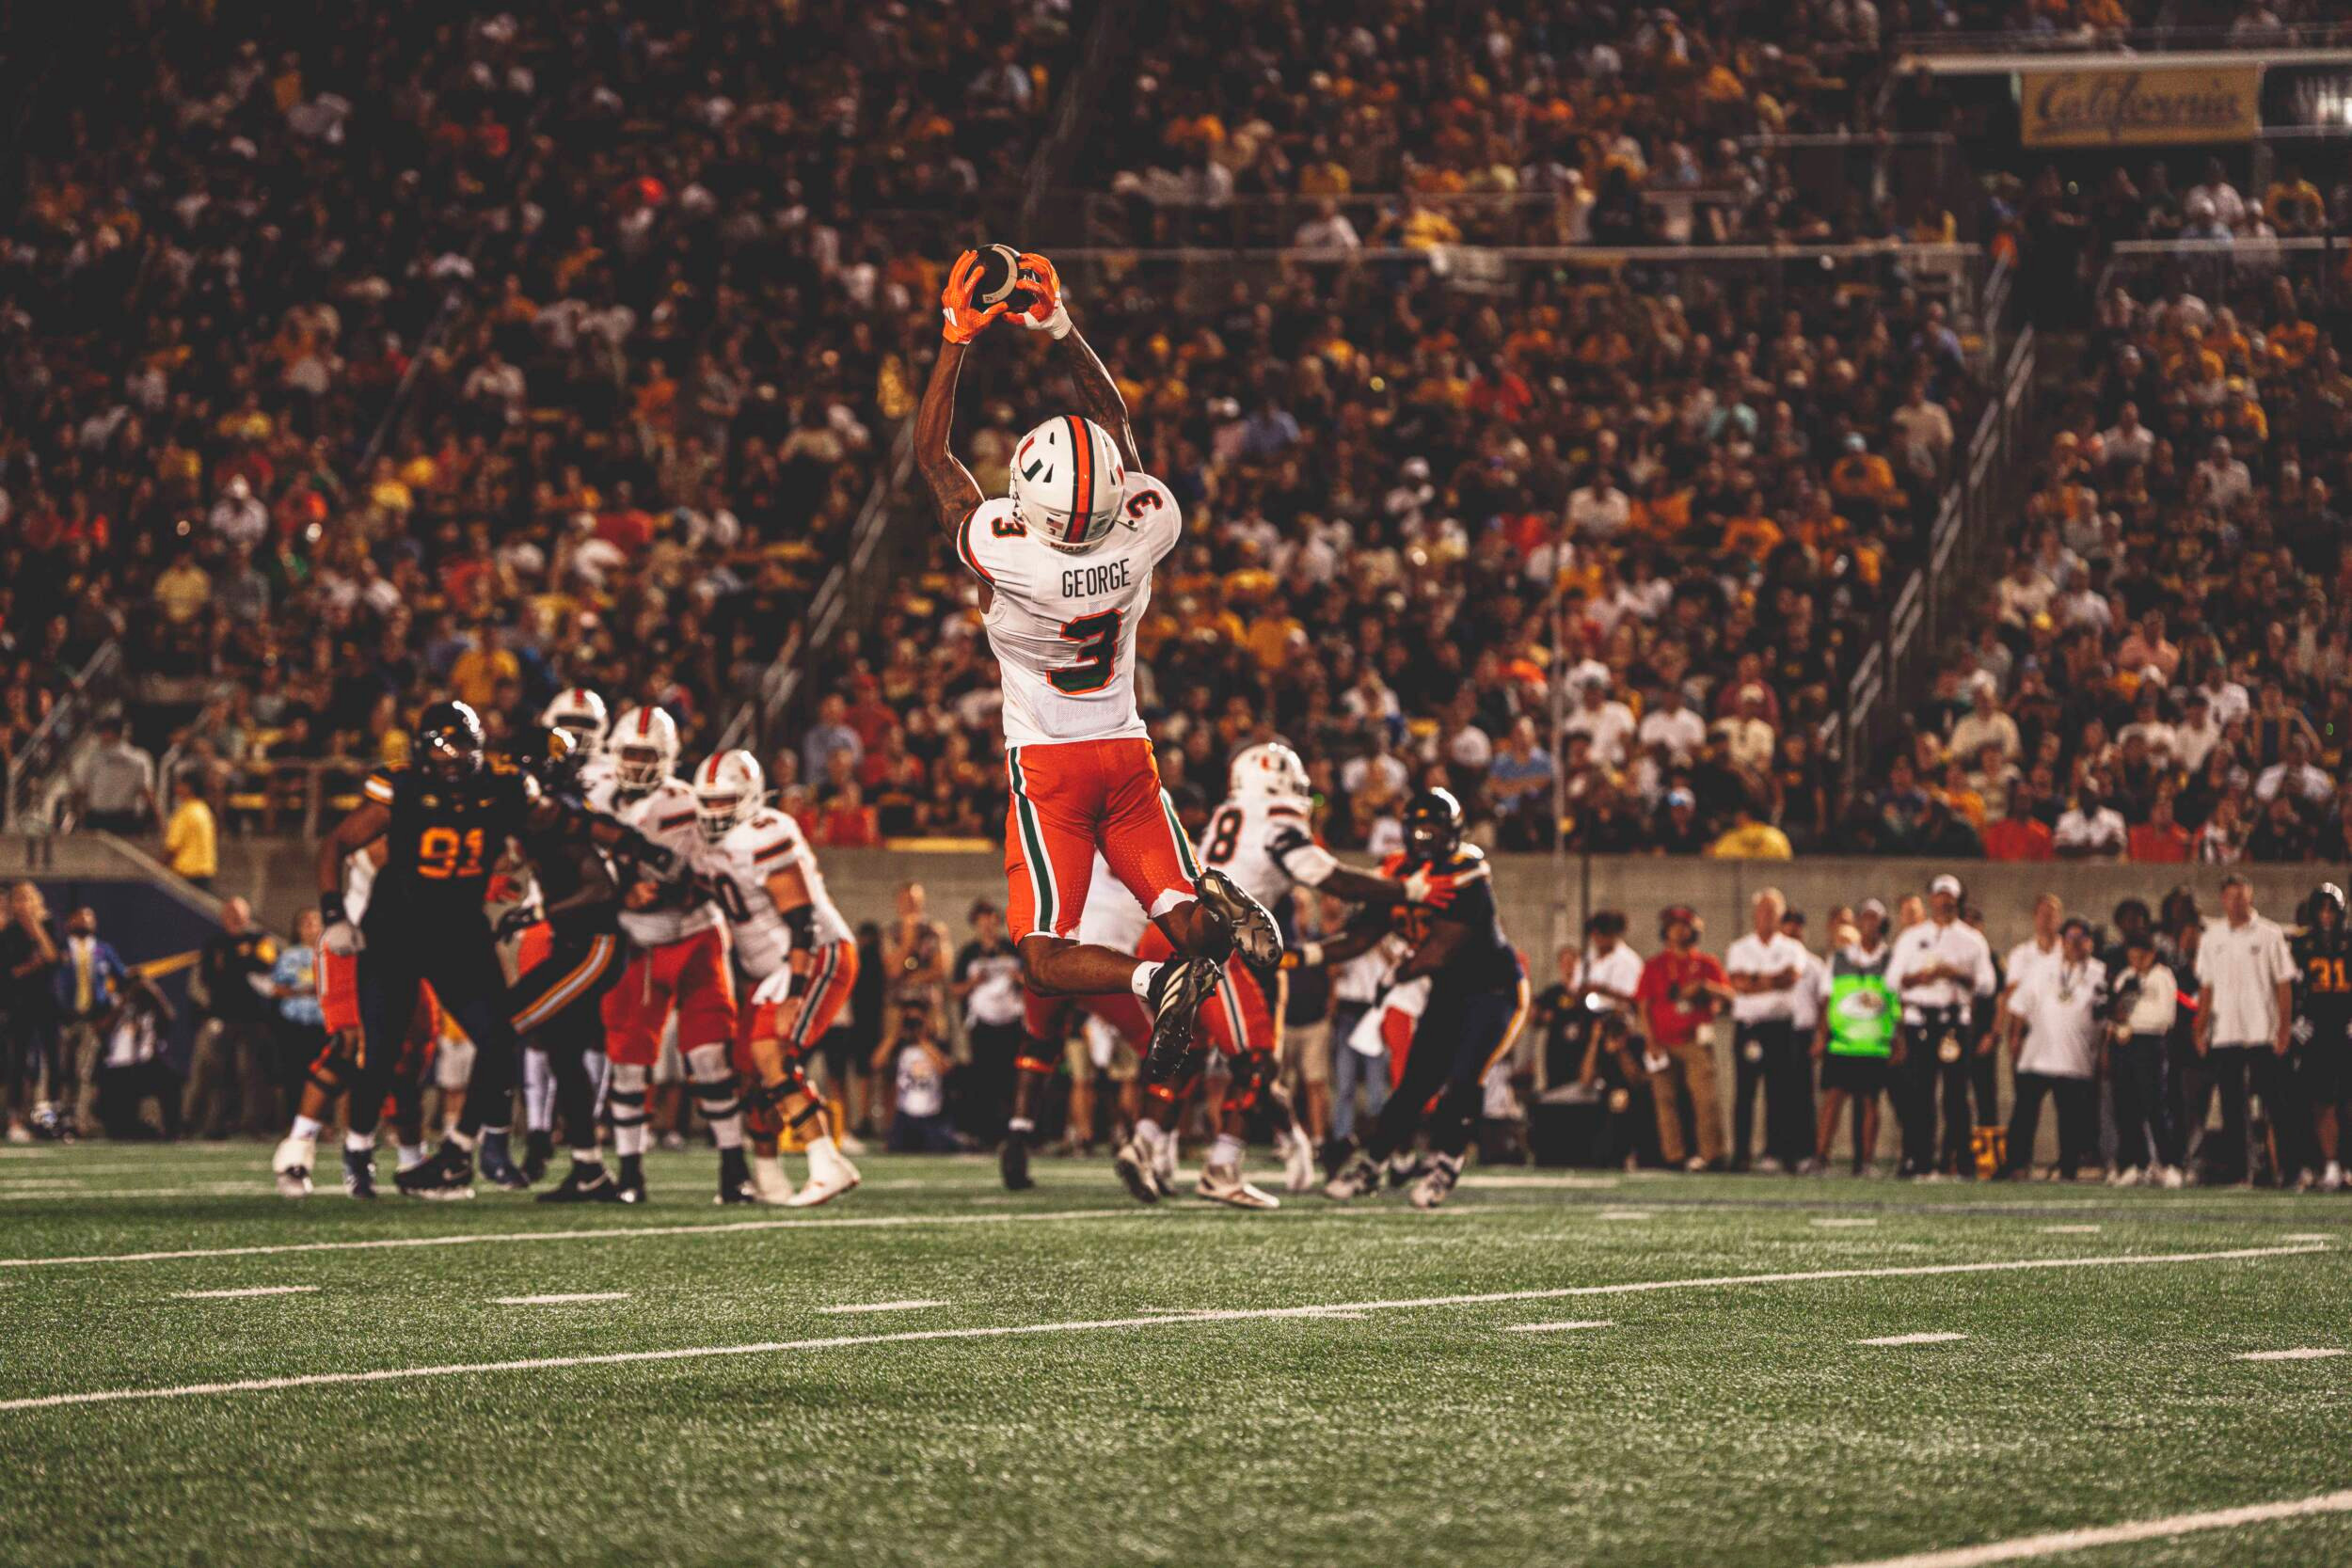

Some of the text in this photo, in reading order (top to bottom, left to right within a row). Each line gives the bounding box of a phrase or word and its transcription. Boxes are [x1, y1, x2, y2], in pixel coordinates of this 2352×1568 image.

[1125, 488, 1164, 519] 3
[991, 516, 1028, 539] 3
[1061, 558, 1131, 598] GEORGE
[1045, 608, 1122, 695] 3
[418, 826, 485, 879] 91
[1205, 806, 1244, 864] 8
[2308, 956, 2351, 993] 31
